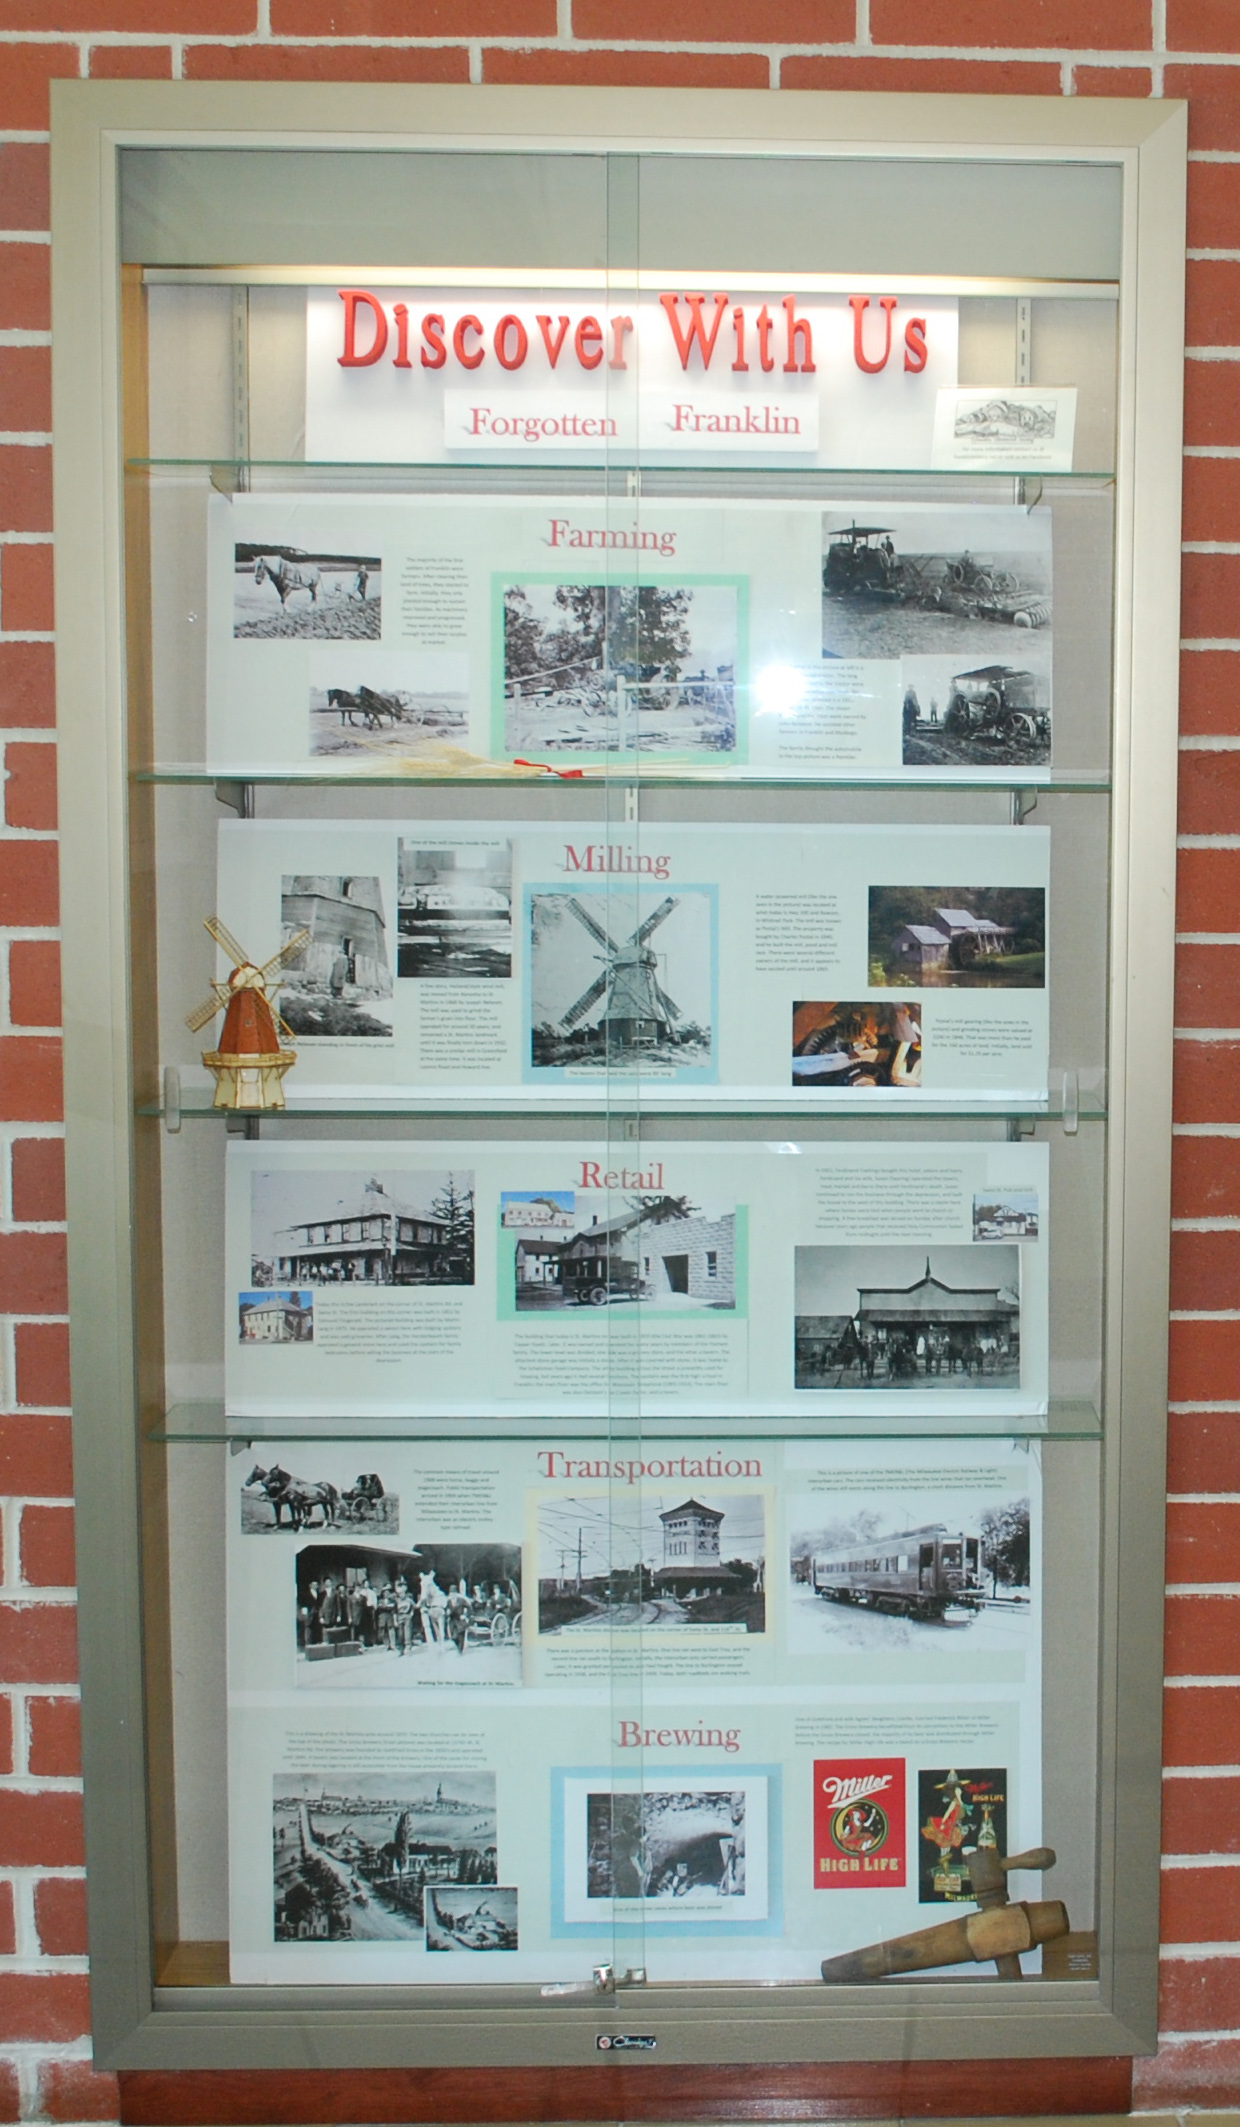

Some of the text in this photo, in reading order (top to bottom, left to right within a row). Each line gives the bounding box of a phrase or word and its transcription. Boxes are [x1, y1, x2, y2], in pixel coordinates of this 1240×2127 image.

[336, 288, 930, 374] Discover With Us
[470, 403, 801, 441] Forgotten Franklin
[549, 519, 676, 555] Farming
[565, 845, 671, 879] Milling
[581, 1161, 664, 1190] Retail
[539, 1451, 762, 1484] Transportation
[619, 1720, 741, 1751] Brewing
[822, 1774, 893, 1807] Miller
[820, 1856, 898, 1872] HIGH LIFE
